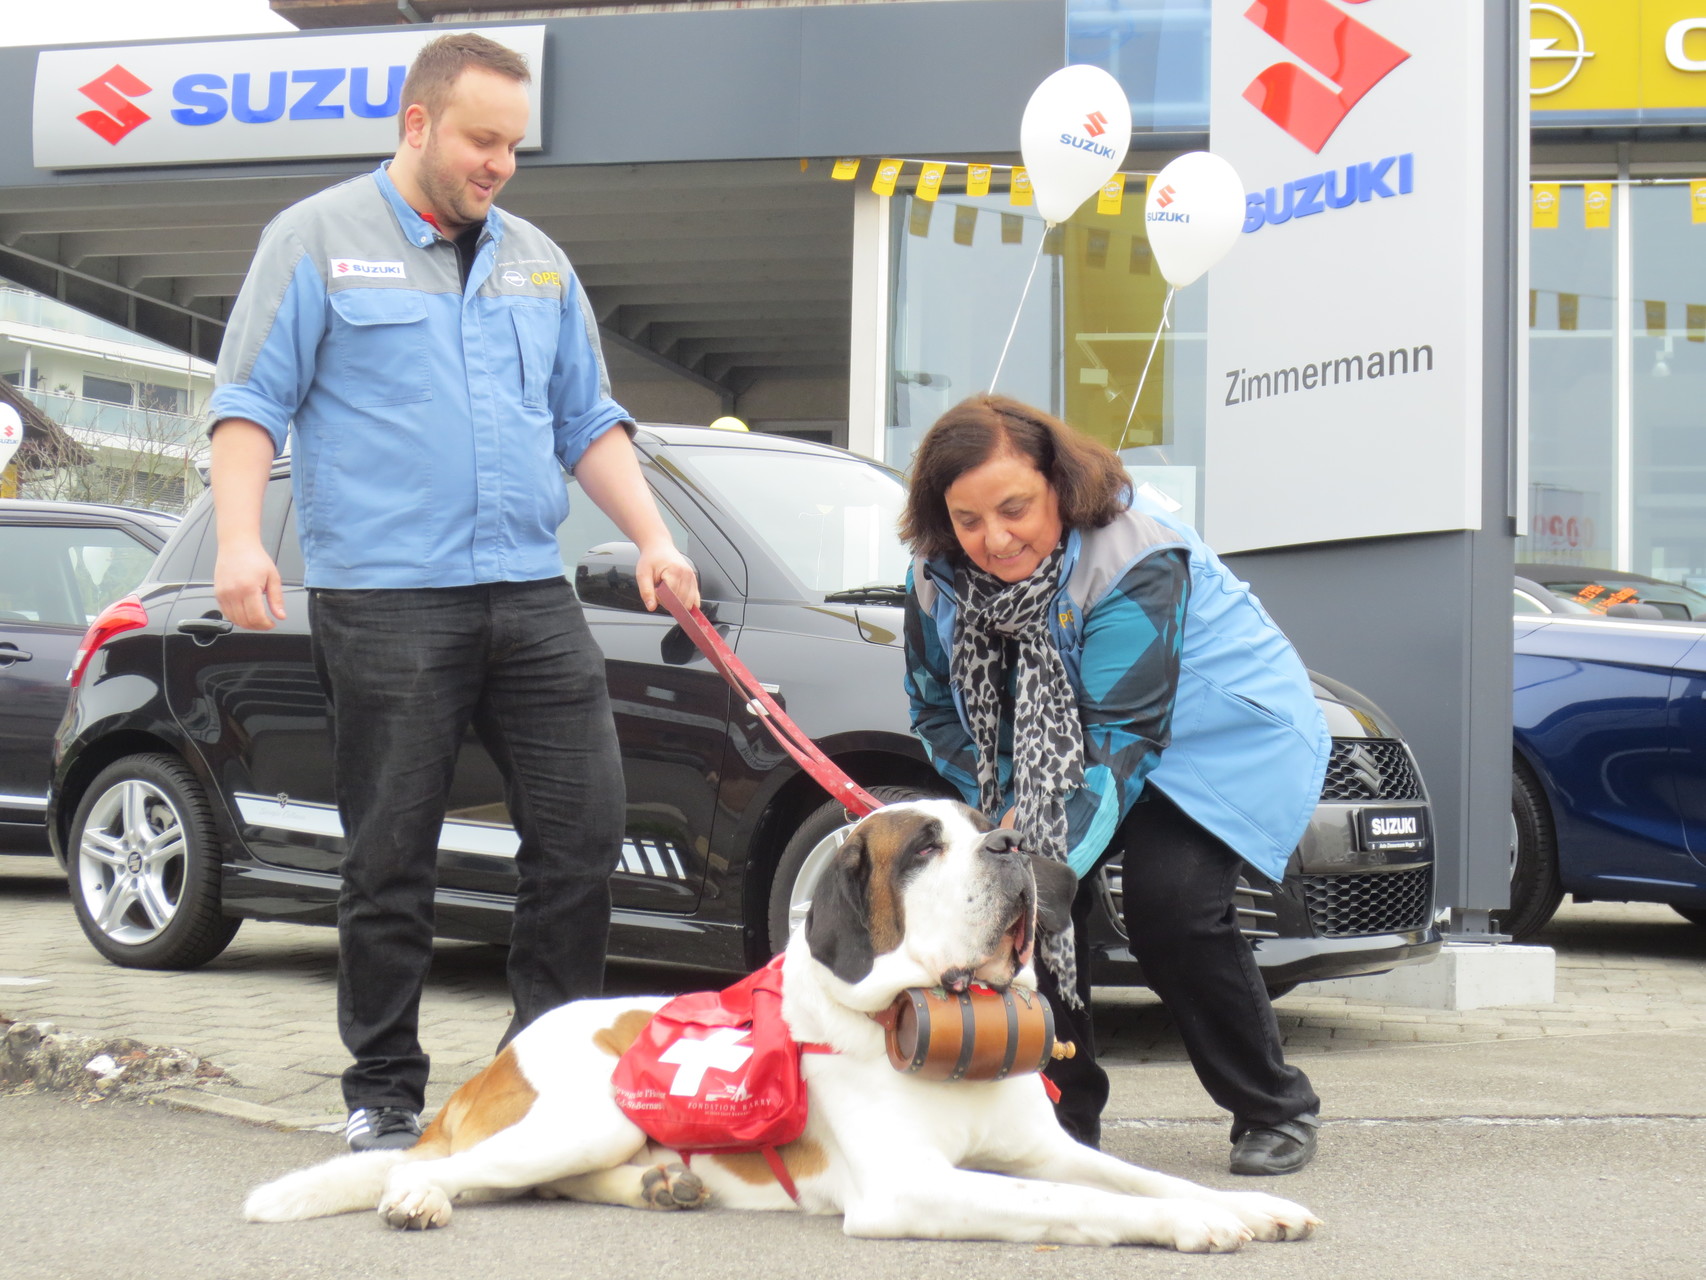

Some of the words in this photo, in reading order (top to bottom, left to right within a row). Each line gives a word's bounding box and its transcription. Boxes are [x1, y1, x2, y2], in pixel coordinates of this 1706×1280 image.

[170, 65, 407, 126] SUZU
[1059, 133, 1116, 160] SUZUKI
[1241, 152, 1414, 234] SUZUKI
[1147, 211, 1190, 224] SUZUKI
[352, 264, 401, 274] SUZUKI
[1225, 344, 1434, 406] Zimmermann
[1371, 817, 1416, 836] SUZUKI
[687, 1102, 737, 1112] FONDATION
